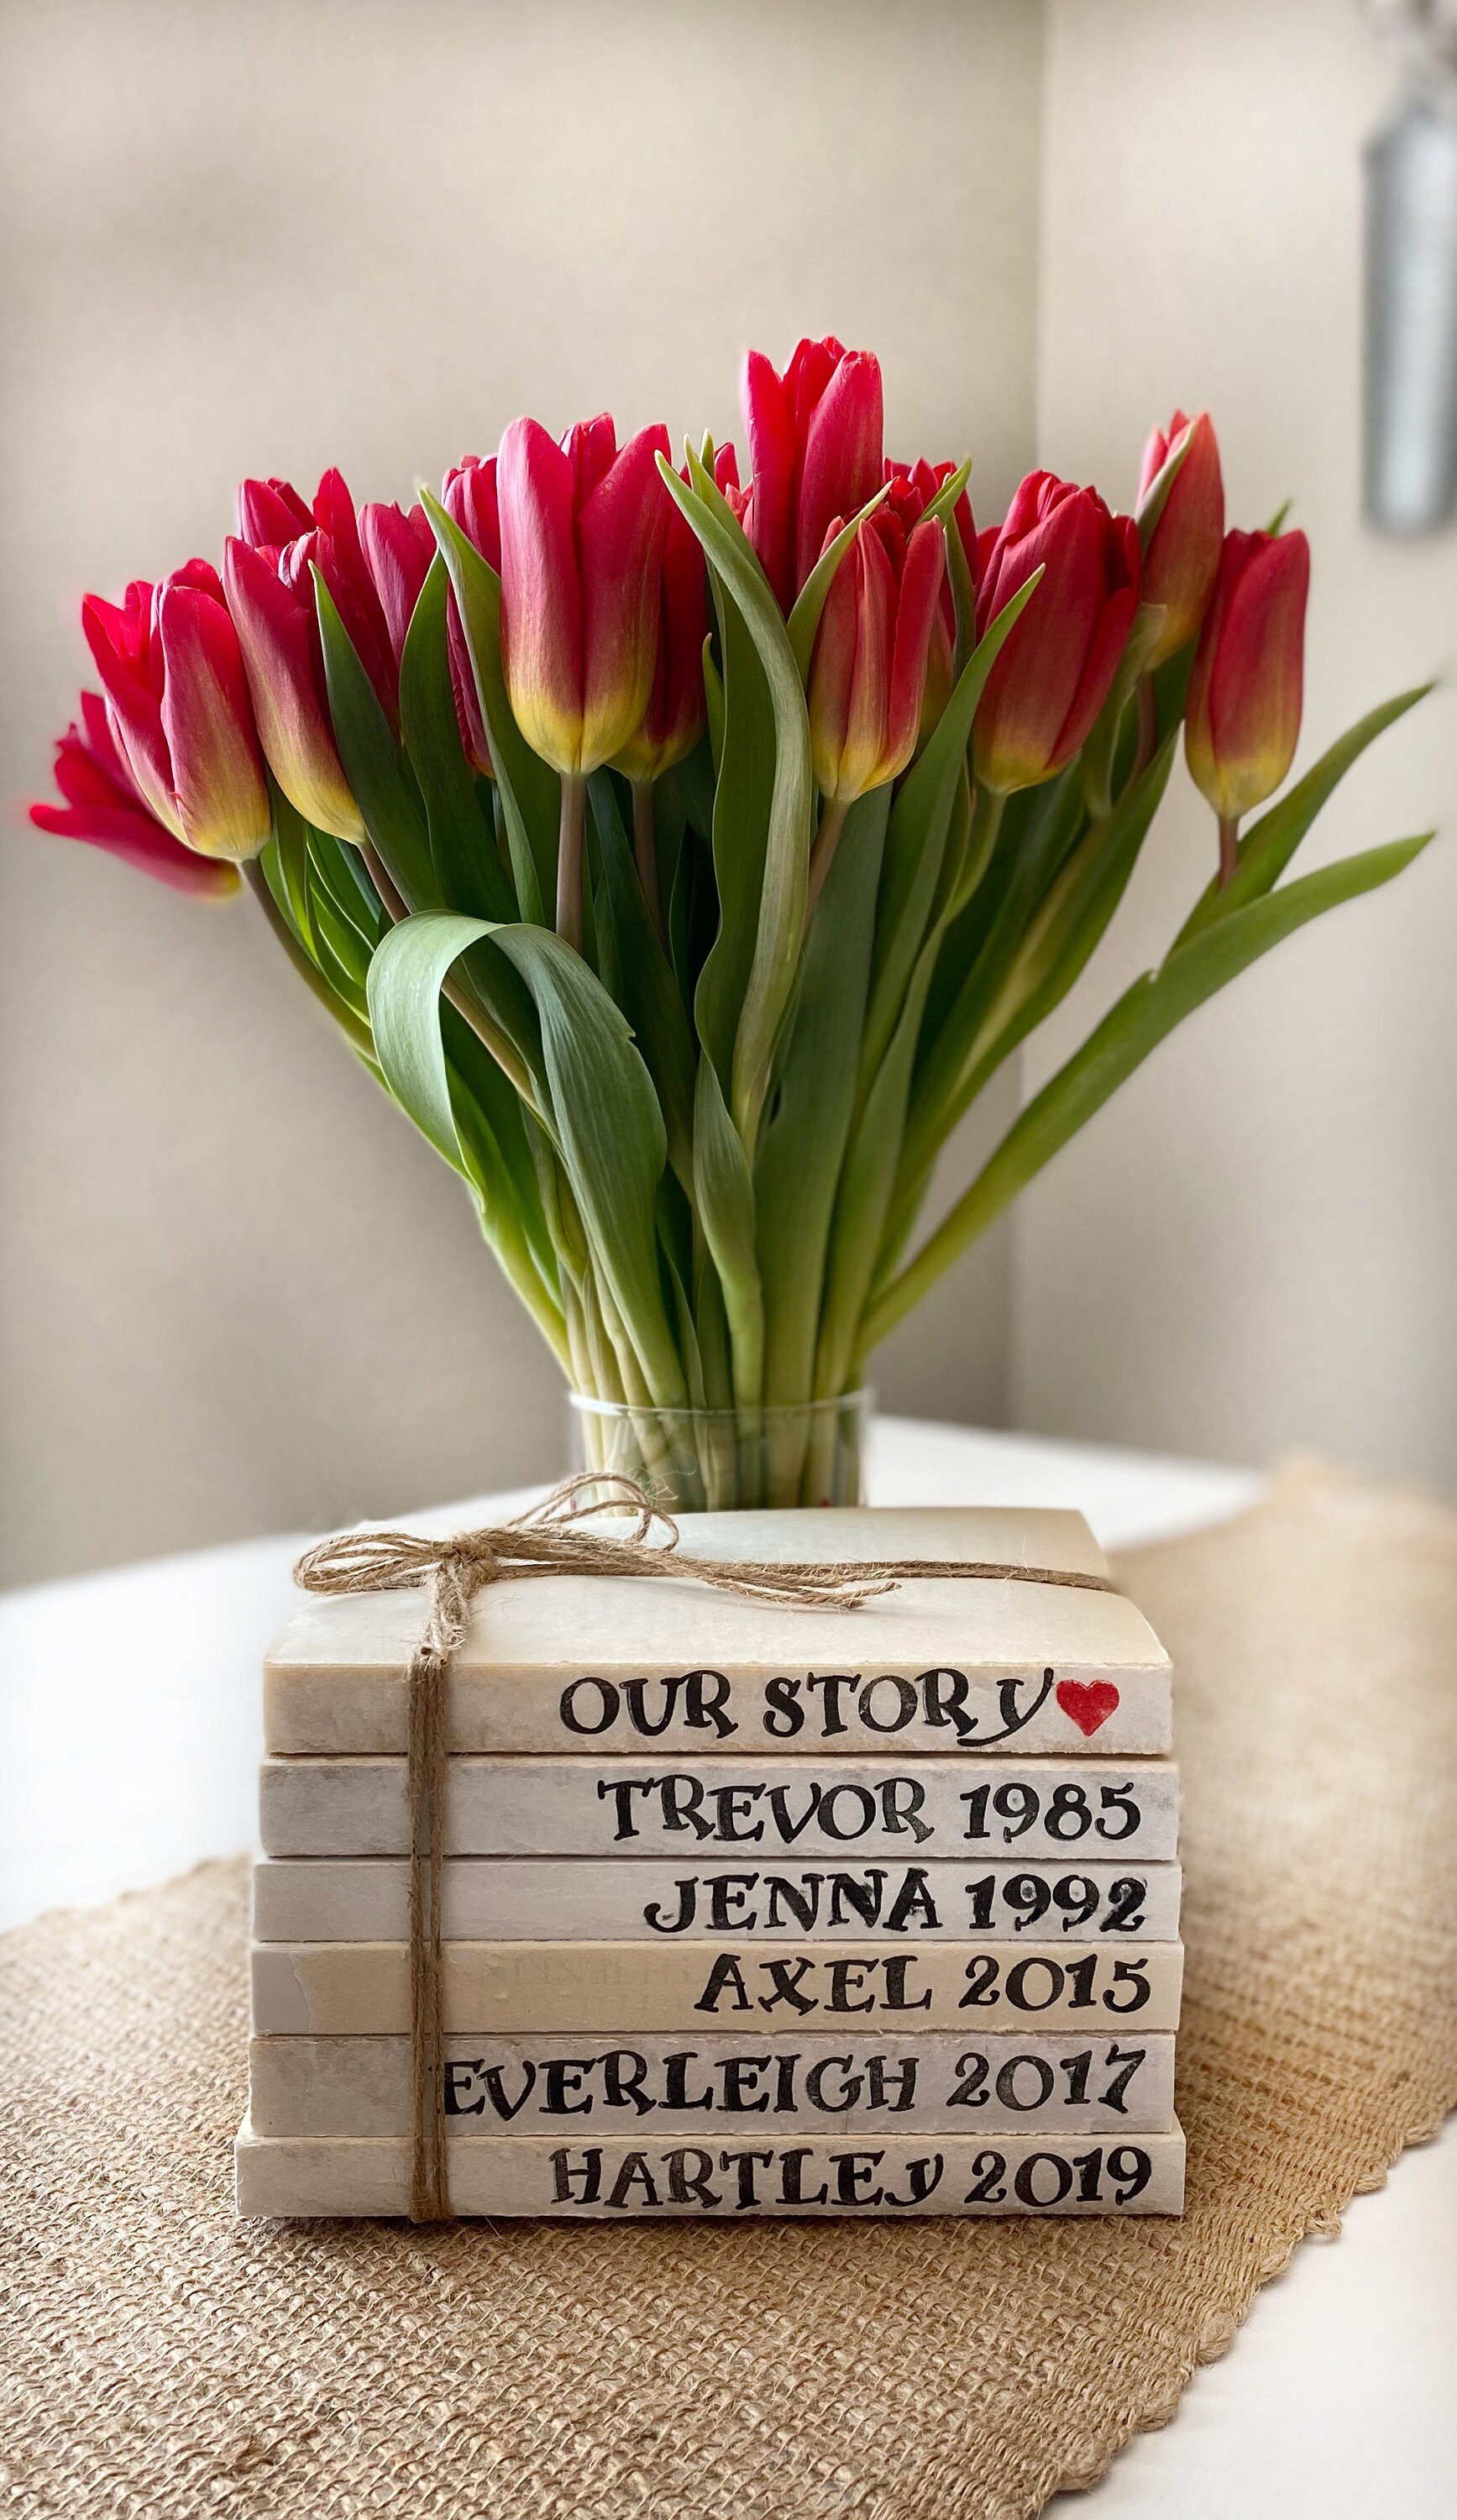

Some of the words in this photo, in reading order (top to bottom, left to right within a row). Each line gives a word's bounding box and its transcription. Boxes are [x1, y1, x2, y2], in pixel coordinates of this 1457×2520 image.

[558, 1669, 739, 1740] OUR
[763, 1667, 1055, 1748] STORY
[597, 1773, 936, 1845] TREVOR
[959, 1782, 1142, 1845] 1985
[643, 1867, 944, 1934] JENNA
[964, 1873, 1147, 1934] 1992
[693, 1953, 933, 2017] AXEL
[957, 1953, 1152, 2014] 2015
[443, 2050, 919, 2122] EVERLEIGH
[945, 2044, 1147, 2114] 2017
[548, 2147, 944, 2211] HARTLEY
[963, 2145, 1153, 2208] 2019
